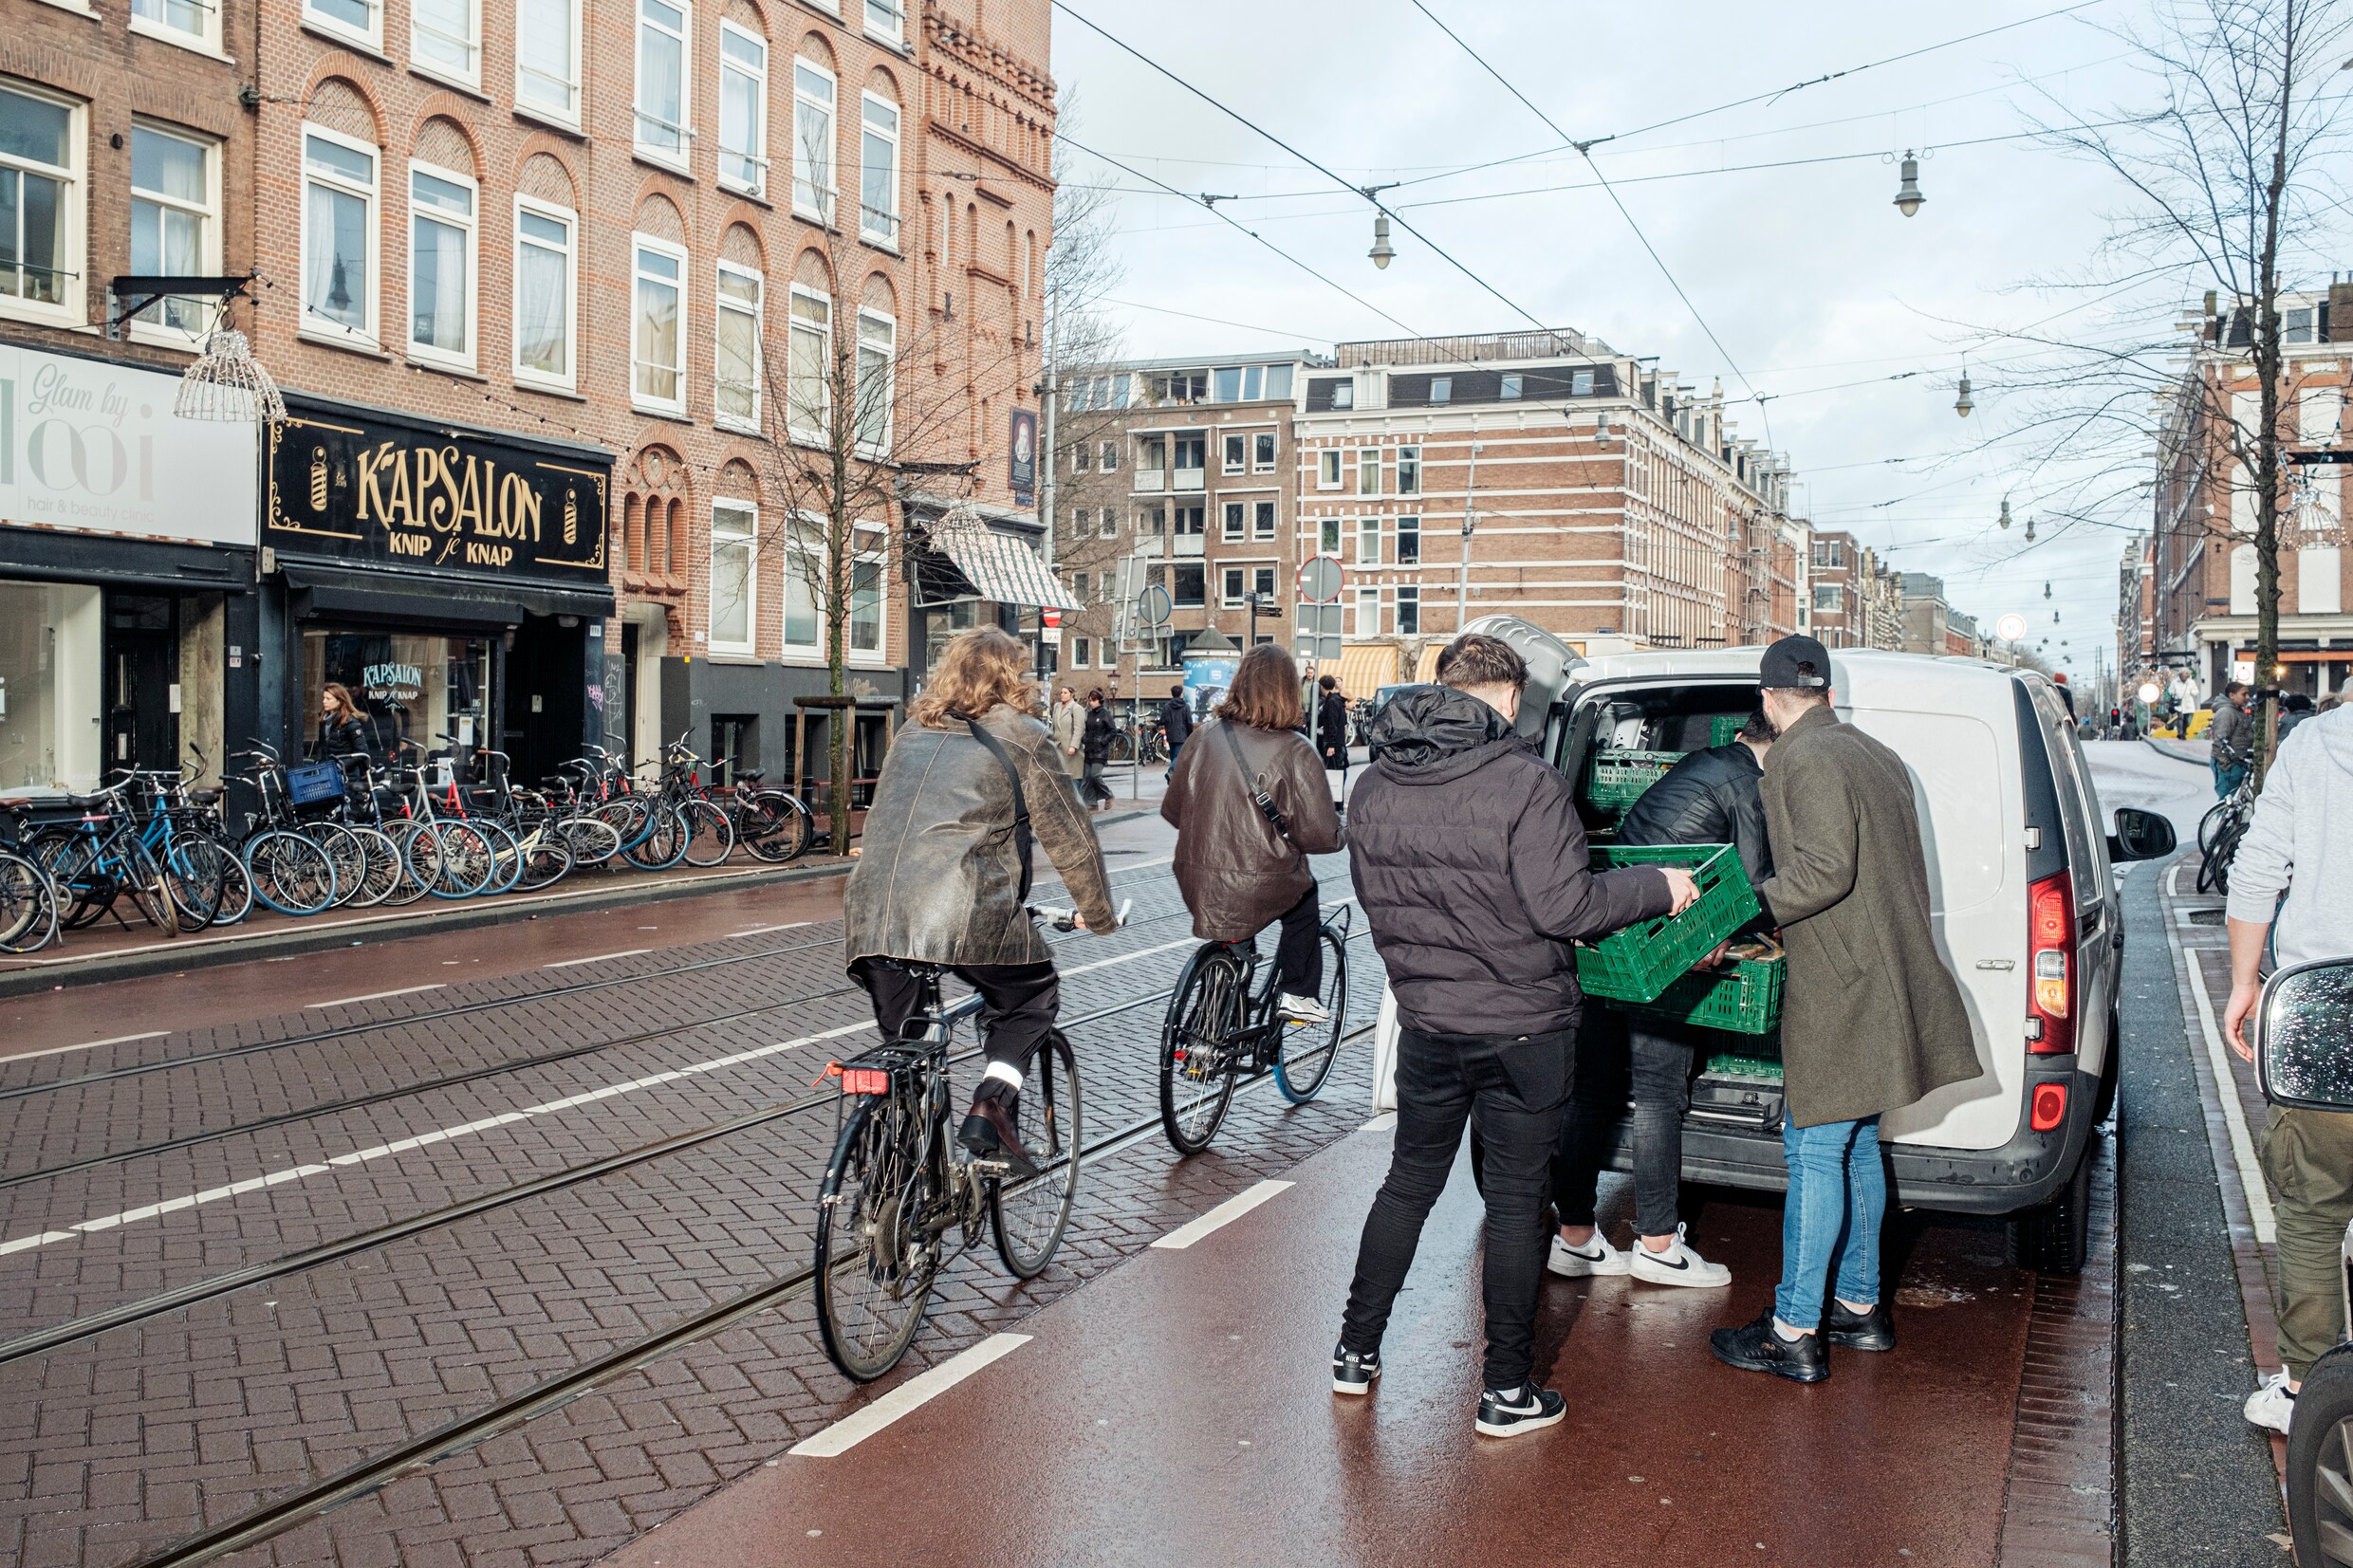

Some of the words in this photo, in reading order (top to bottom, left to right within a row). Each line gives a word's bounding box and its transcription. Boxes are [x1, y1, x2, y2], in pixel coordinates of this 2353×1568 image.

[28, 363, 95, 415] Glam
[101, 381, 129, 427] by
[356, 440, 543, 543] KAPSALON
[28, 495, 54, 512] hair
[57, 499, 68, 513] &
[71, 501, 118, 522] beauty
[121, 507, 155, 523] clinic
[389, 531, 432, 557] KNIP
[435, 531, 461, 565] je
[466, 542, 513, 567] KNAP
[363, 661, 422, 690] KAPSALON
[368, 691, 387, 700] KNIP
[398, 691, 418, 700] KNAP
[1345, 1355, 1361, 1363] NIKE
